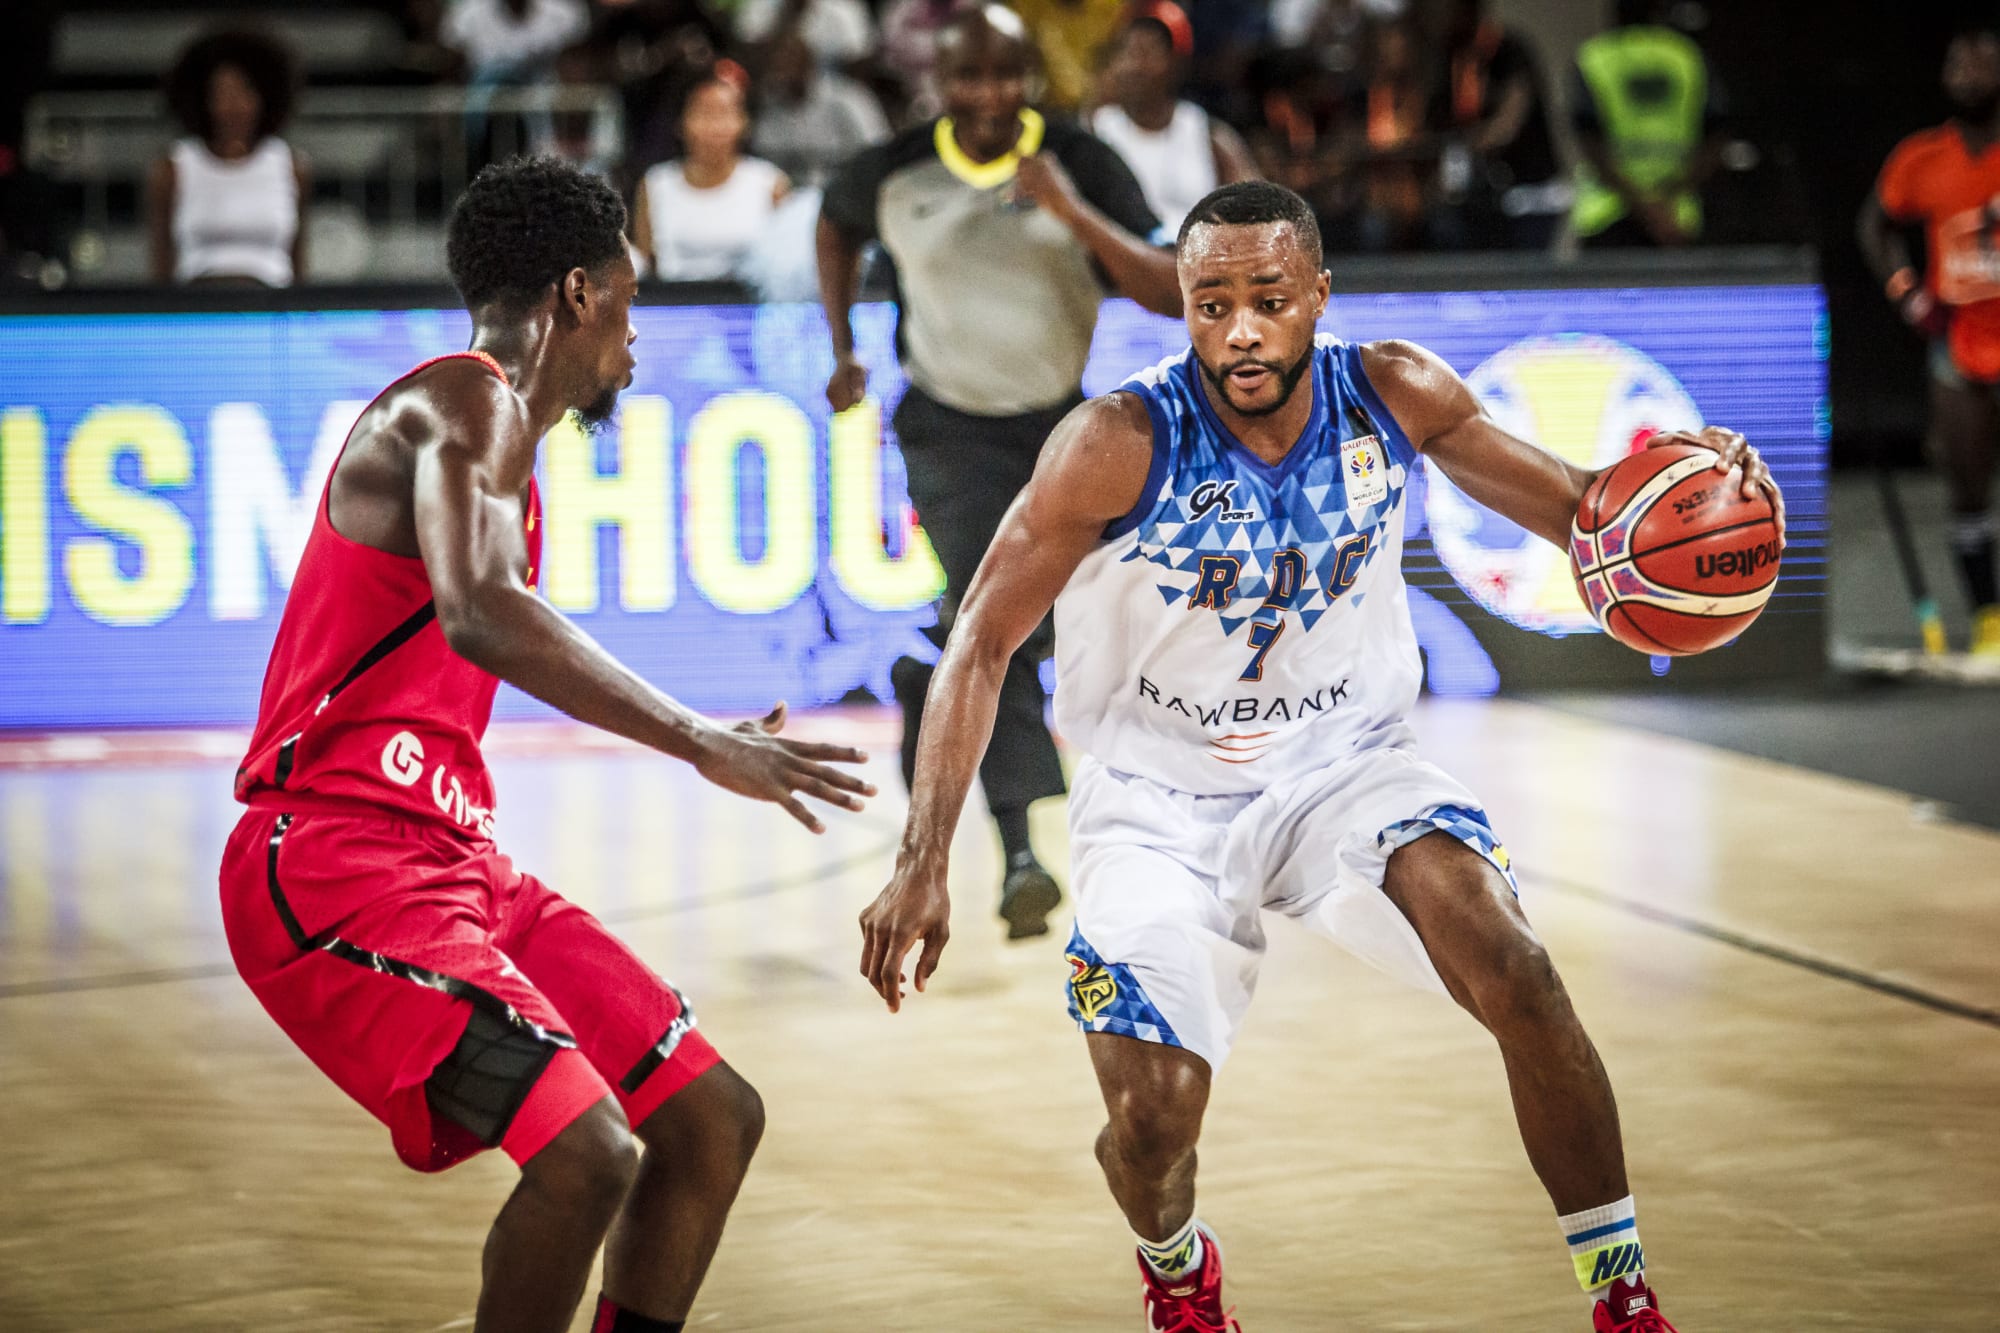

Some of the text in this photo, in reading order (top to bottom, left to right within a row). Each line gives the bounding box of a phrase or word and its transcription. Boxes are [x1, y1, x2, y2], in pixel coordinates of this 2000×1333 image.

[1353, 491, 1372, 501] WORLD
[1373, 488, 1384, 496] CUP
[1188, 534, 1368, 611] RDC
[1695, 539, 1780, 578] molten
[1238, 618, 1285, 682] 7
[1139, 676, 1349, 727] RAWBANK
[1590, 1243, 1645, 1285] NIK
[1629, 1296, 1648, 1309] NIKE
